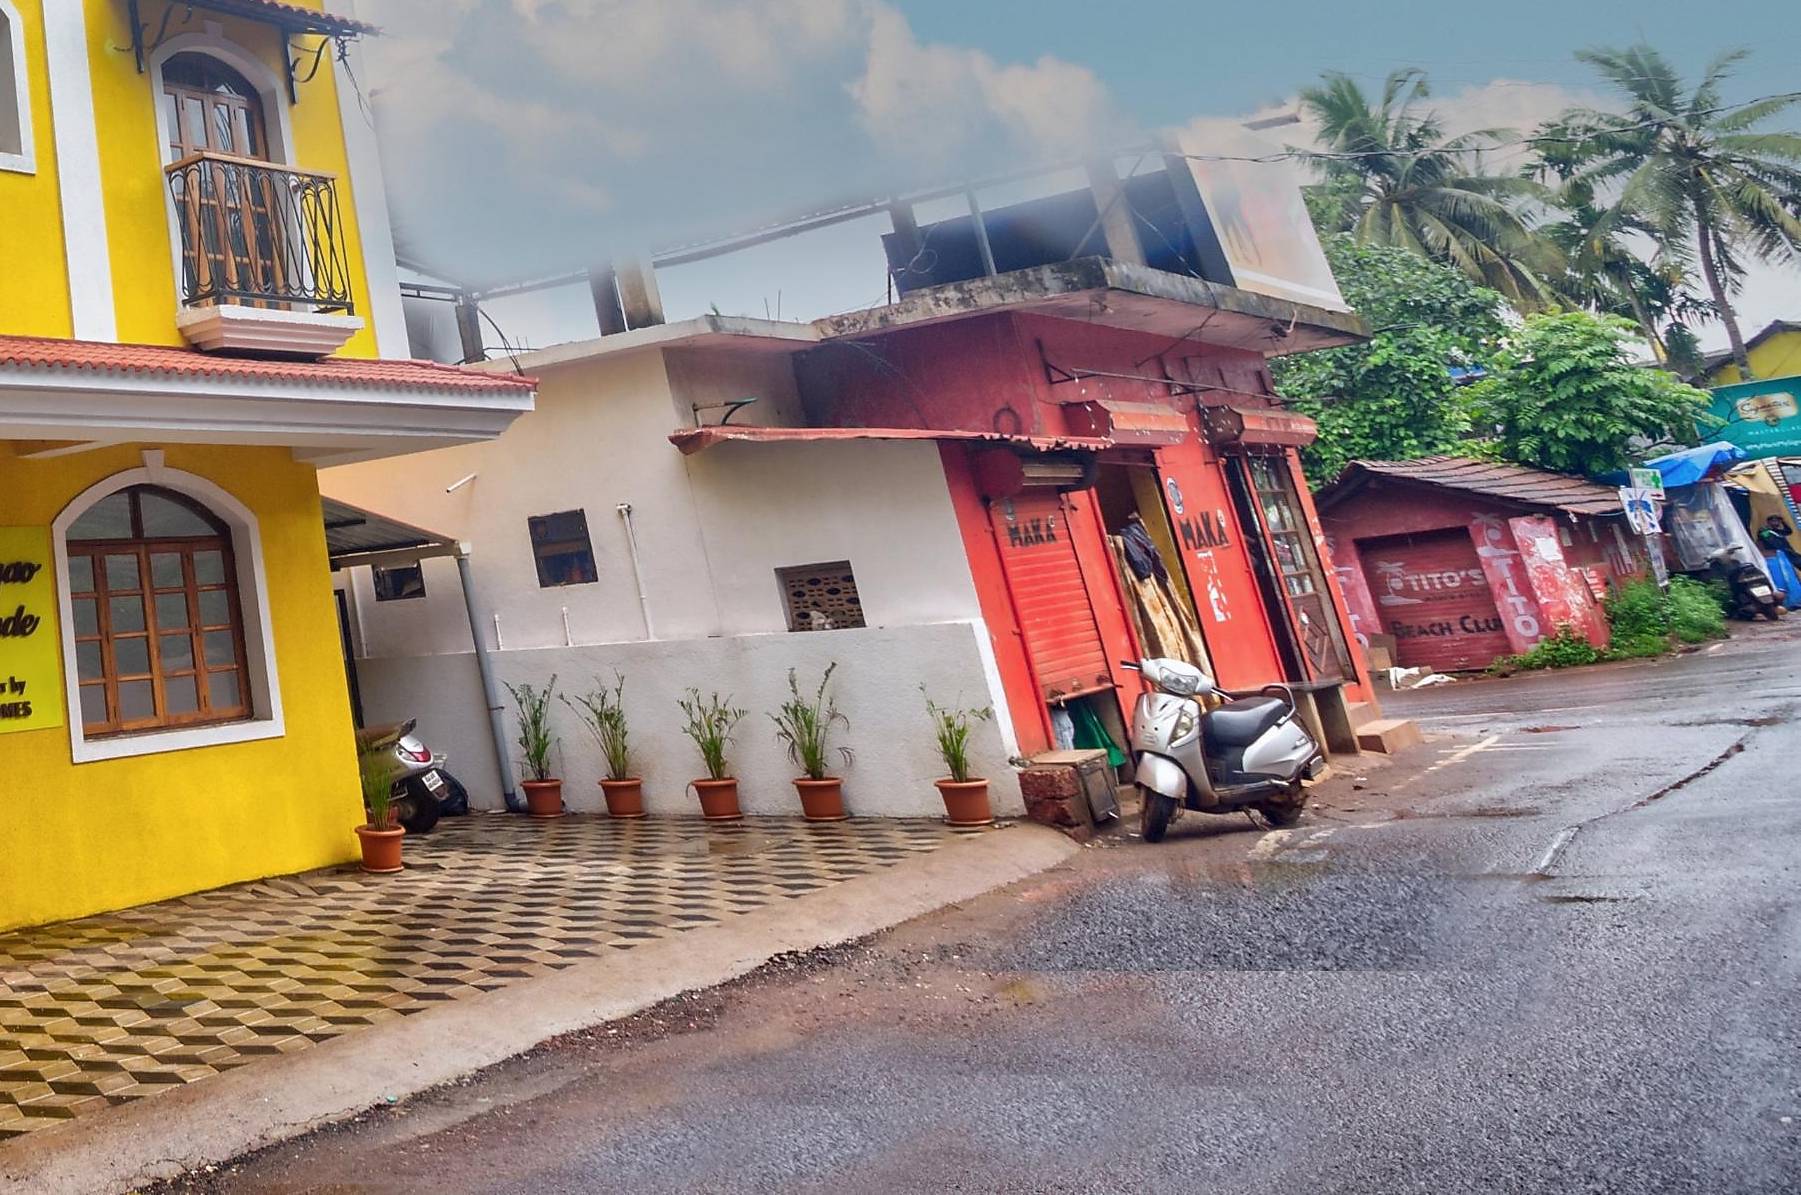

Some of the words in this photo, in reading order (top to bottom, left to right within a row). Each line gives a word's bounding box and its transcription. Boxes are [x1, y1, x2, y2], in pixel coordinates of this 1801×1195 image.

[1006, 518, 1057, 547] MAKA
[1178, 511, 1231, 550] MAKA
[1405, 569, 1487, 591] TITO'S
[9, 676, 26, 696] by
